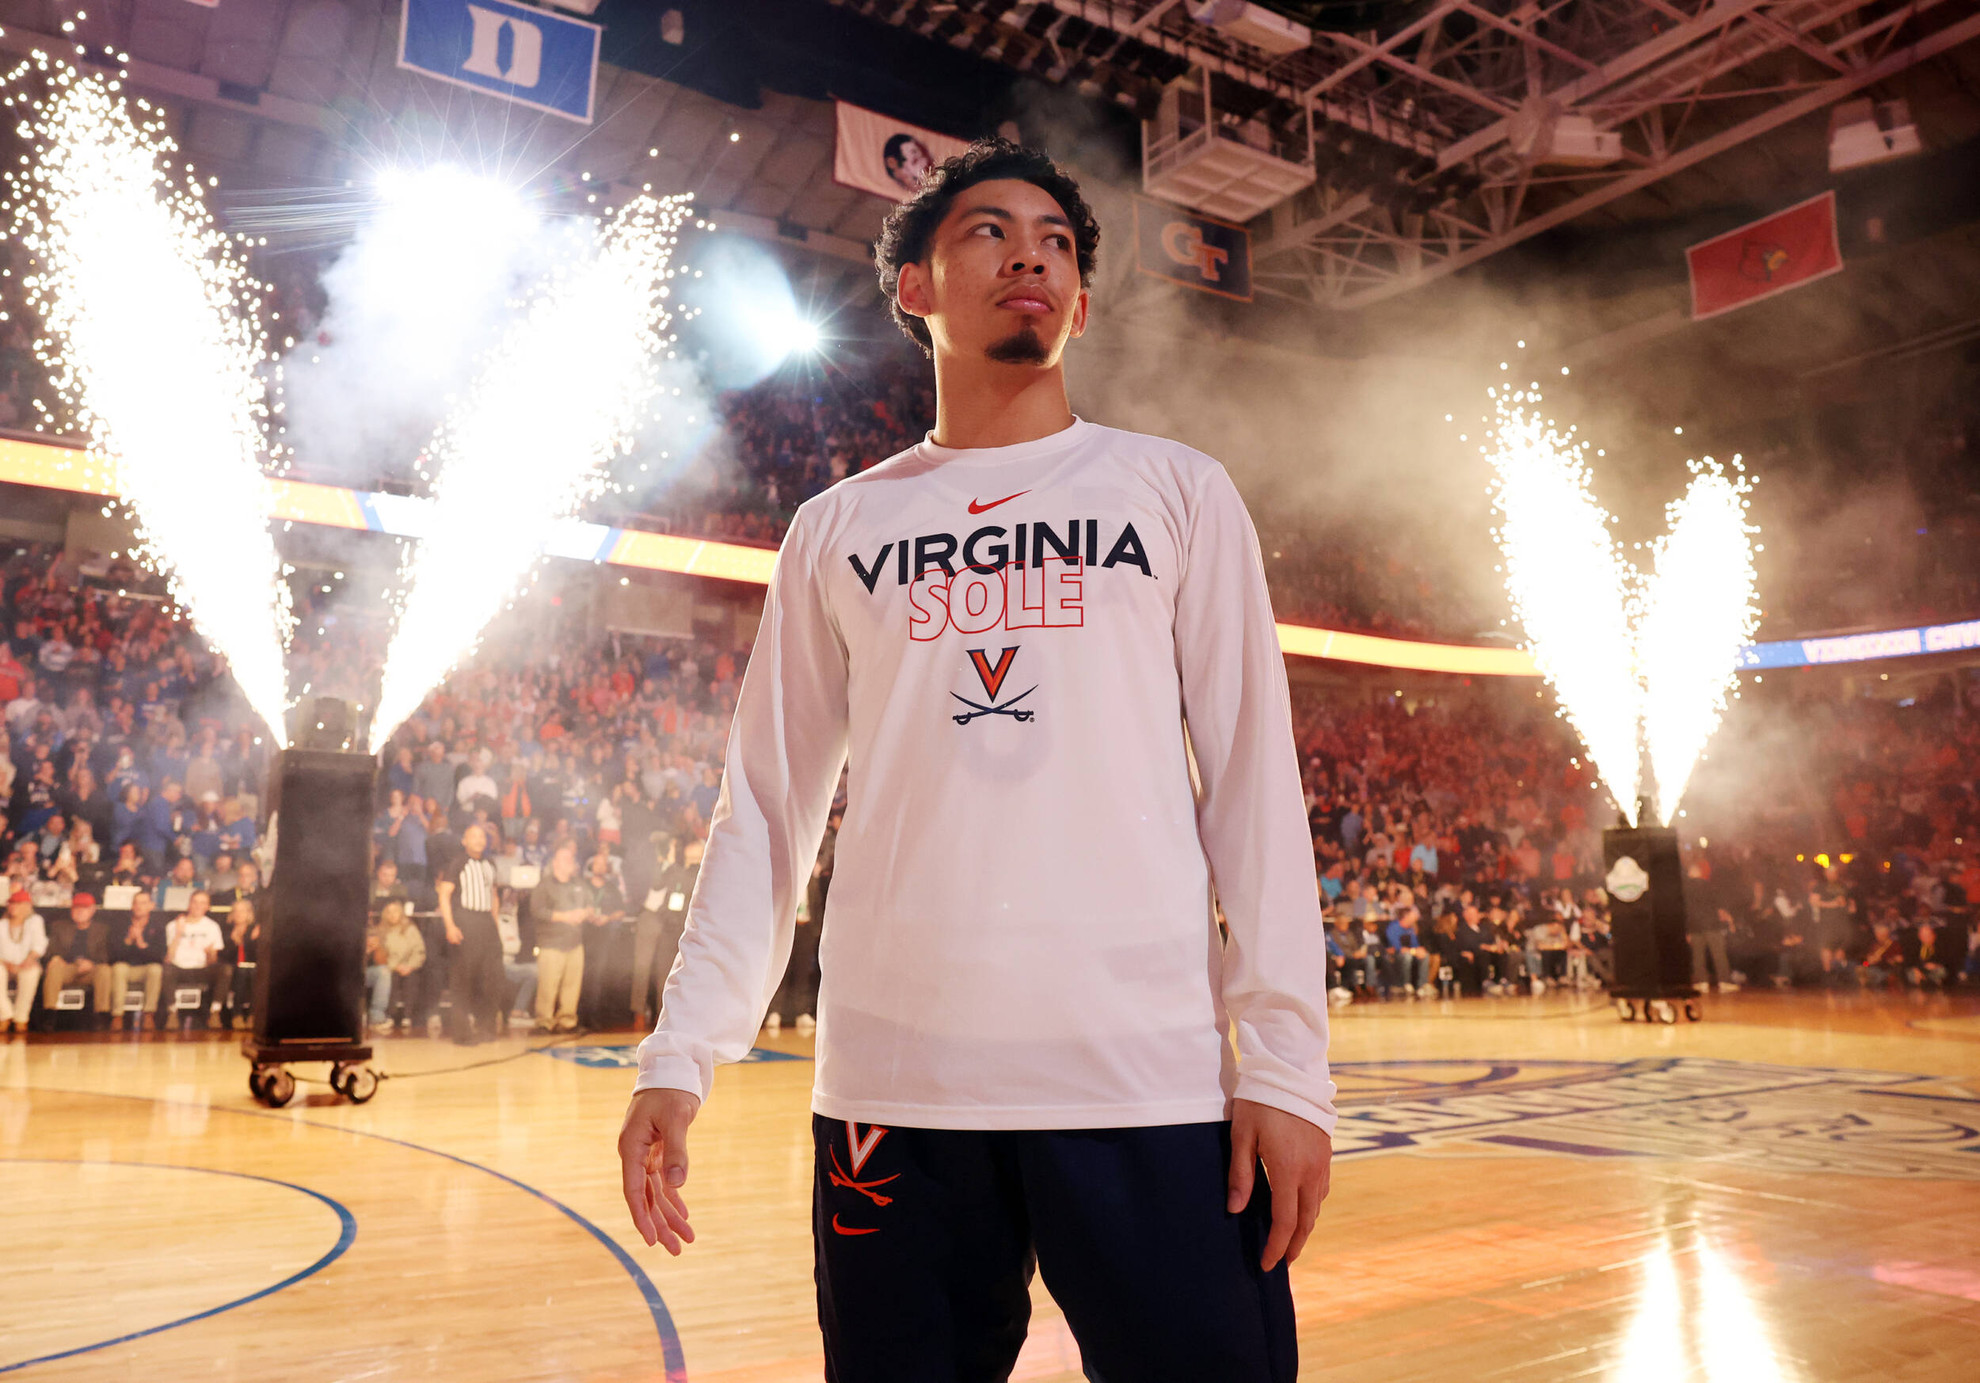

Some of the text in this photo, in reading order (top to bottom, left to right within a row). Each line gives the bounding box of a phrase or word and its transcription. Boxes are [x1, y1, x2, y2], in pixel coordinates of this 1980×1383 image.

[462, 4, 542, 88] D
[847, 519, 1153, 595] VIRGINIA
[909, 556, 1084, 641] SOLE
[965, 645, 1022, 704] V
